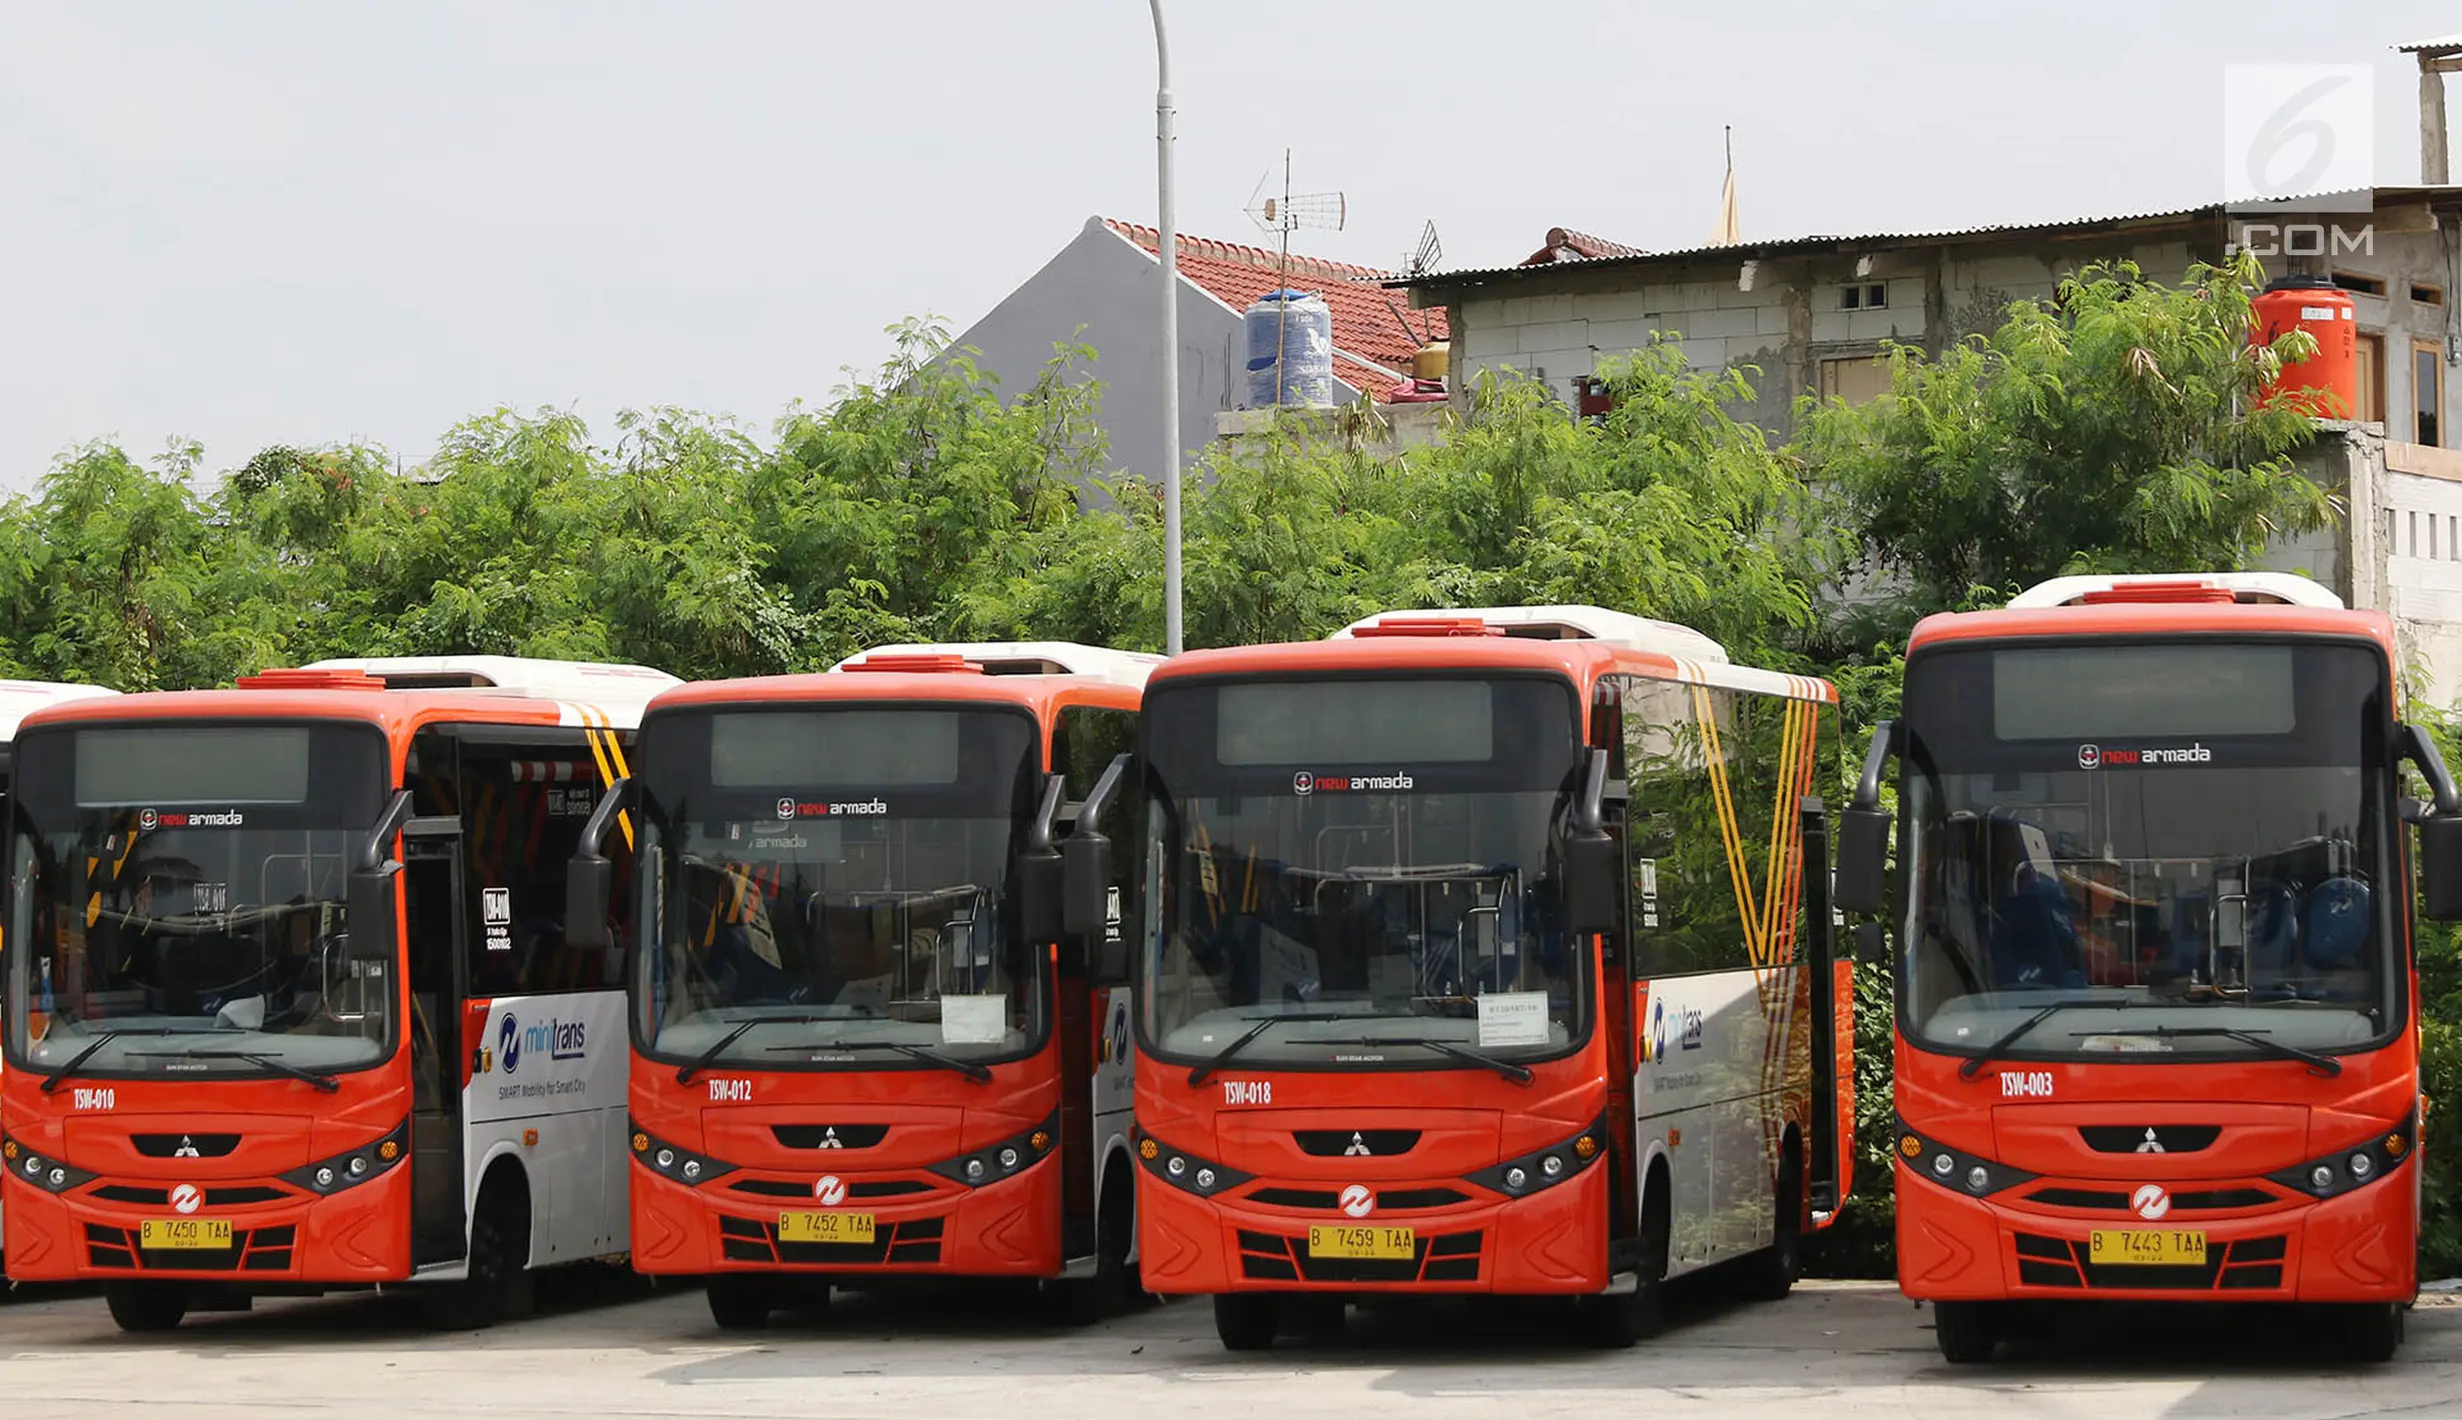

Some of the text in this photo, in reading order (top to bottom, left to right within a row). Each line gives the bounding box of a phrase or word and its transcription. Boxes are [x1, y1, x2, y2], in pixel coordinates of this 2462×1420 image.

[2101, 743, 2211, 763] new armada
[1315, 771, 1413, 789] new armada
[797, 797, 887, 814] new armada
[159, 809, 242, 826] new armada
[524, 1018, 585, 1060] minitrans
[709, 1079, 751, 1101] TSW-012
[1224, 1081, 1271, 1104] TSW-018
[2000, 1072, 2053, 1096] TSW-003
[74, 1088, 115, 1109] TSW-010
[143, 1221, 230, 1239] B 7450 TAA
[781, 1214, 872, 1233] B 7452 TAA
[1311, 1228, 1411, 1248] B 7459 TAA
[2093, 1232, 2204, 1252] B 7443 TAA
